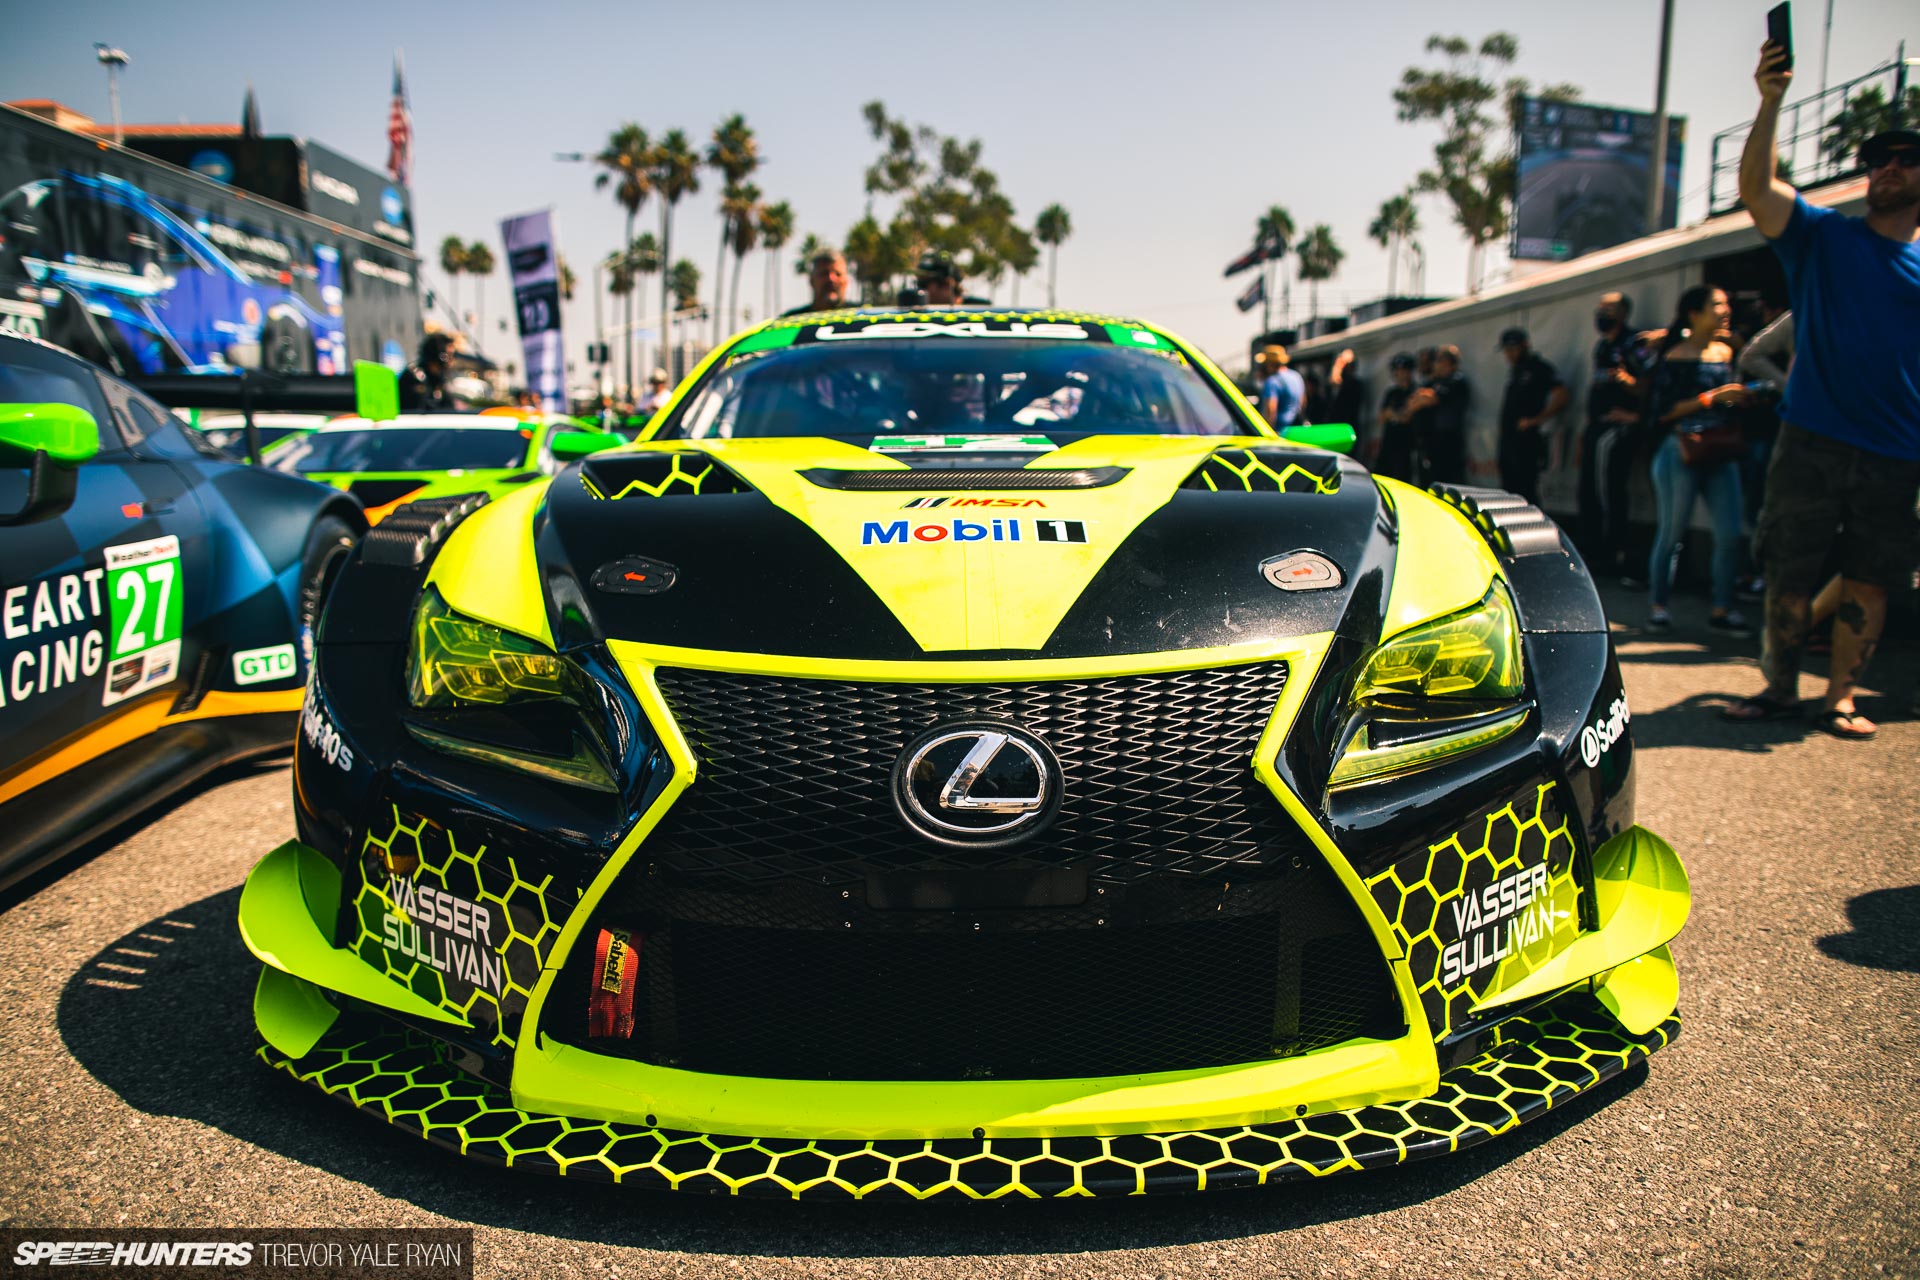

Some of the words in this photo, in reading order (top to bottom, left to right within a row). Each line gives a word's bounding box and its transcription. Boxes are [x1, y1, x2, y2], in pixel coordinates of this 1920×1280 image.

[815, 322, 1089, 341] LEXUS
[862, 518, 1021, 545] Mobil
[950, 498, 1047, 508] IMSA
[3, 568, 104, 640] EART
[116, 562, 174, 655] 27
[0, 629, 104, 708] CING
[240, 653, 292, 676] GTD
[389, 872, 492, 946] VASSER
[1452, 862, 1548, 940] VASSER
[383, 913, 501, 999] SULLIVAN
[1443, 899, 1555, 986] SULLIVAN
